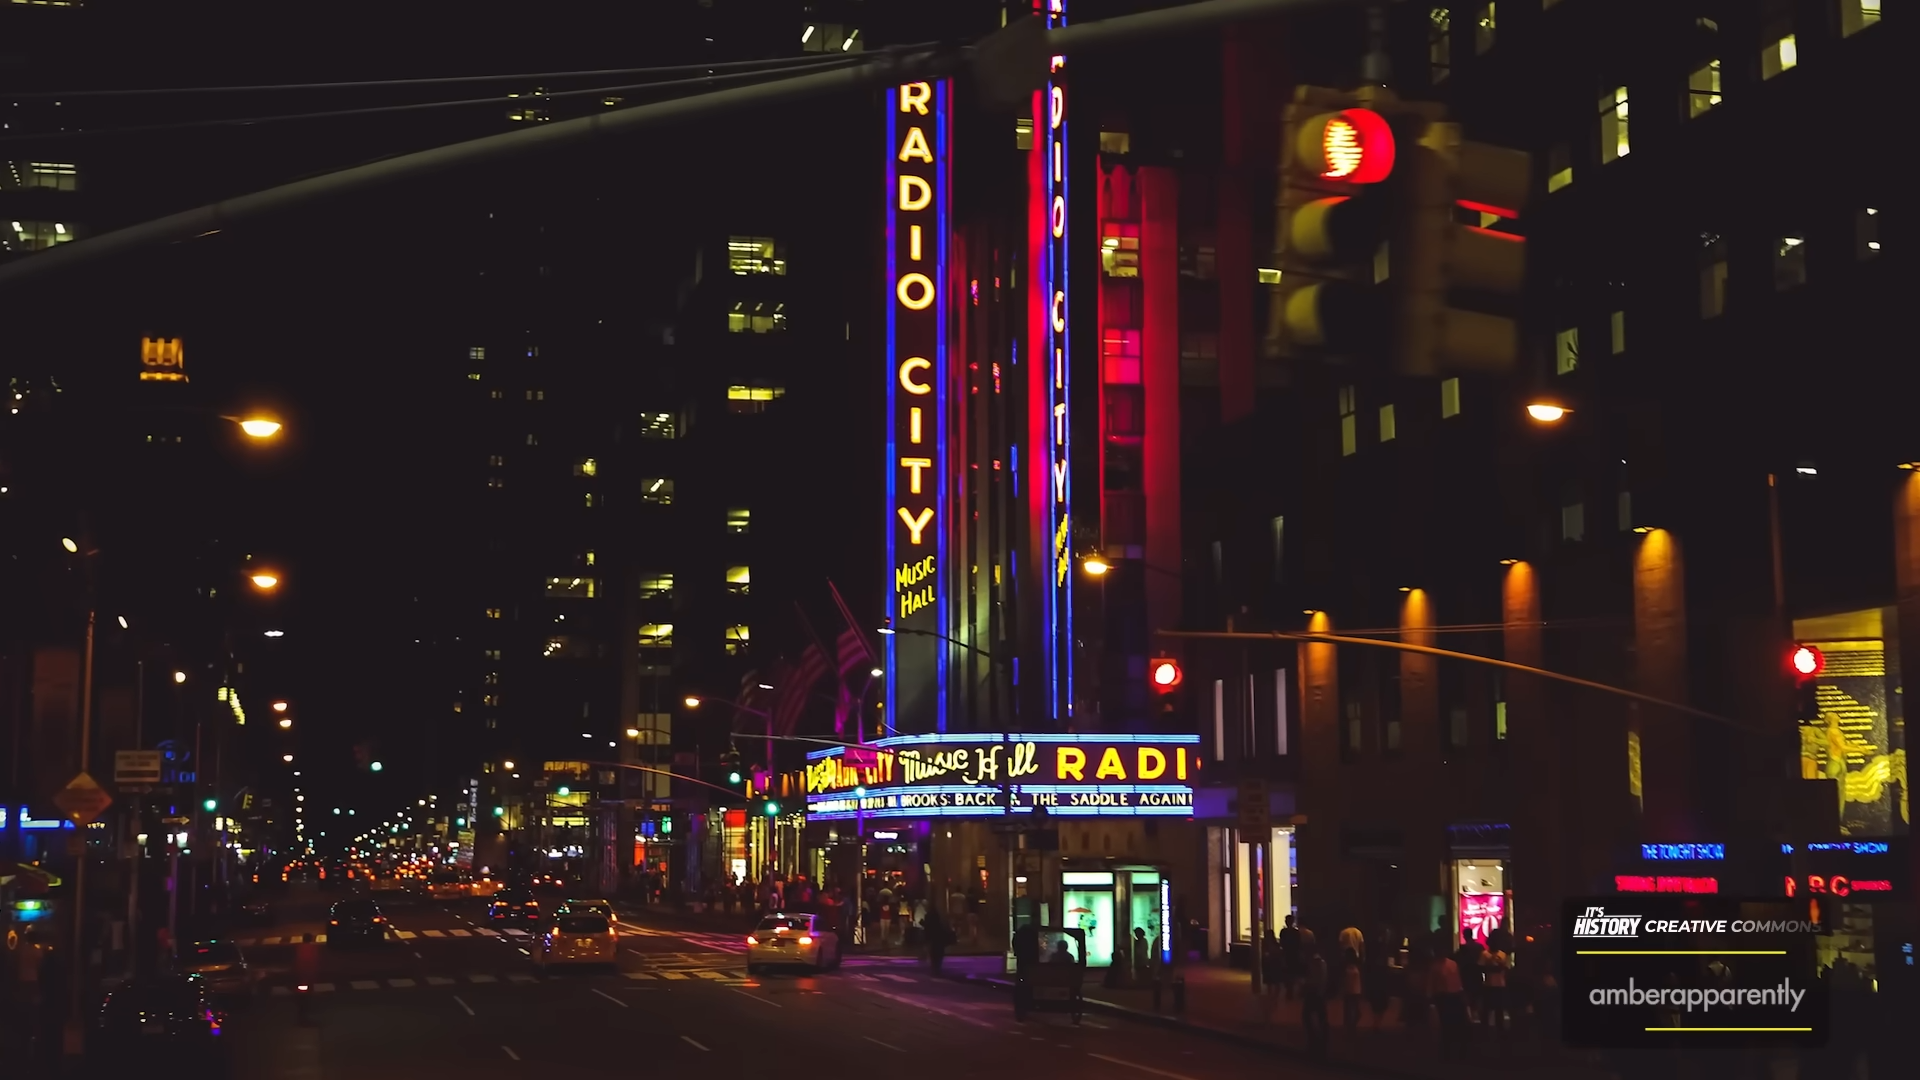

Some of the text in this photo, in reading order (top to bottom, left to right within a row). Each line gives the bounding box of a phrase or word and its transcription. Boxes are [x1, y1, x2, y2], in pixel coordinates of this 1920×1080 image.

[897, 81, 935, 544] RADIO CITY
[1051, 290, 1067, 502] CITY
[901, 585, 936, 618] HALL
[1056, 746, 1202, 781] RADI
[954, 793, 996, 806] BACK
[1031, 793, 1059, 806] THE
[1070, 793, 1129, 806] SADDLE
